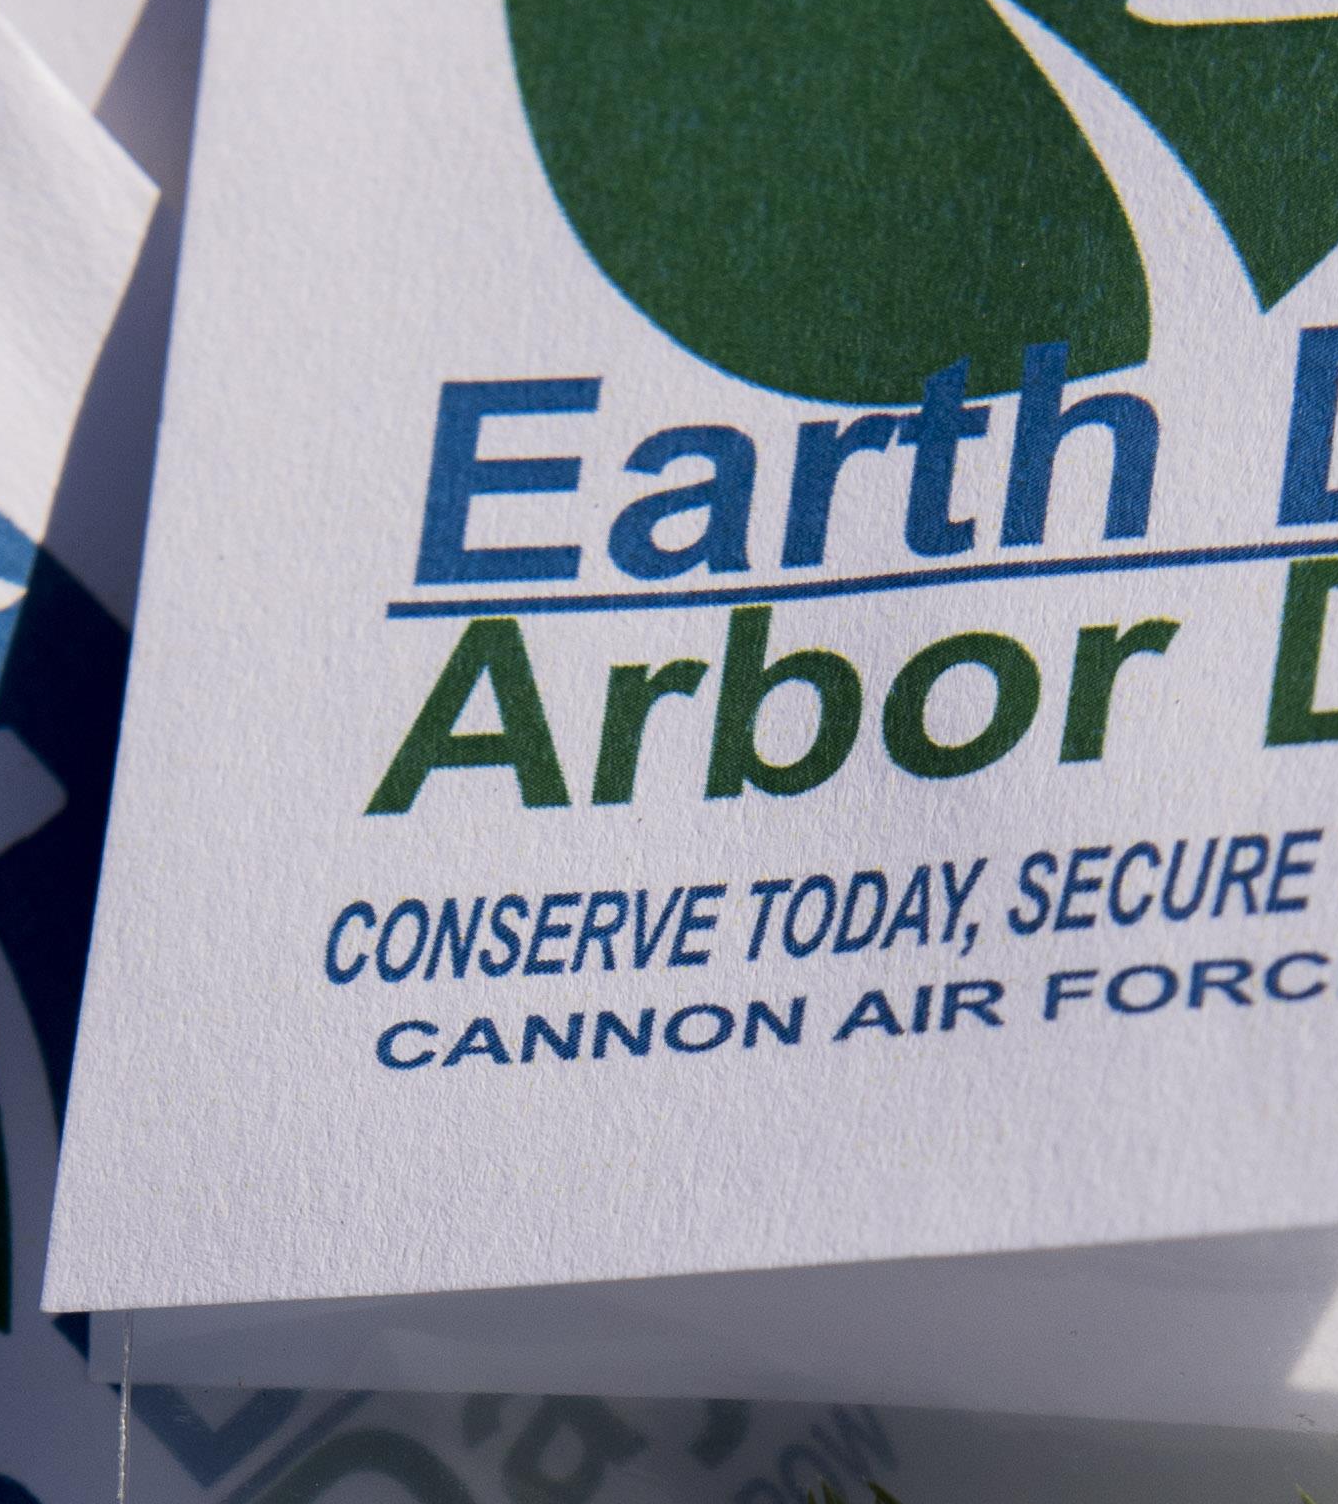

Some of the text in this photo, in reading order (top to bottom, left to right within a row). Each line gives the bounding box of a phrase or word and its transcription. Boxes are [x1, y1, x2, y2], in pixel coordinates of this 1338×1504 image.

[412, 341, 1163, 588] Earth
[364, 605, 1181, 817] Arbor
[324, 883, 730, 987] CONSERVE
[742, 858, 987, 963] TODAY,
[1006, 829, 1318, 938] SECURE
[373, 1000, 805, 1071] CANNON
[832, 979, 1006, 1037] AIR
